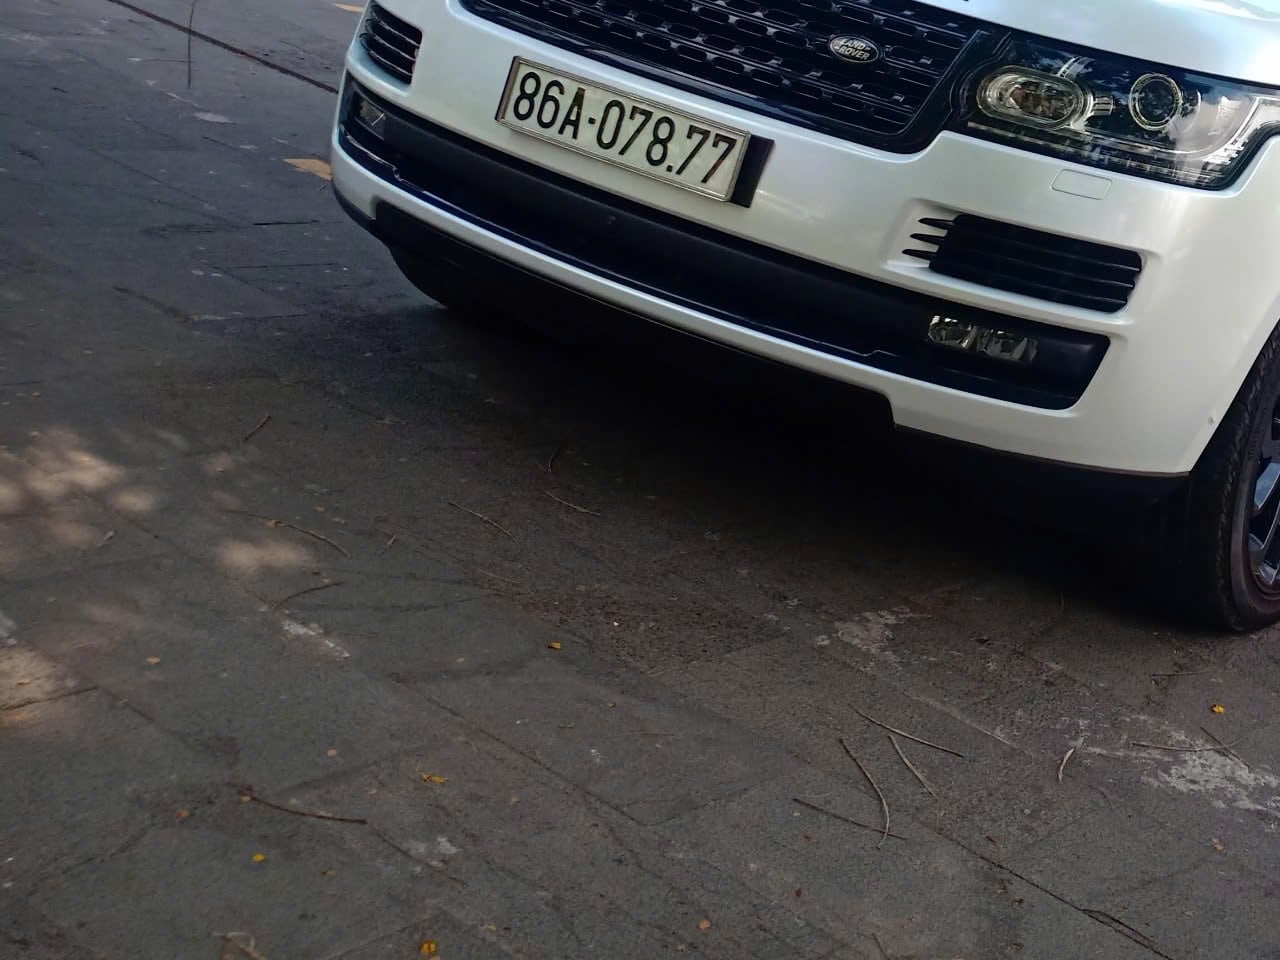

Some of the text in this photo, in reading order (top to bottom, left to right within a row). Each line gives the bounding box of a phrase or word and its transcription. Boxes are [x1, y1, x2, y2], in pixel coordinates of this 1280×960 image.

[839, 38, 866, 51] LAND
[838, 45, 871, 60] ROVER
[513, 71, 738, 184] 86A-078.77
